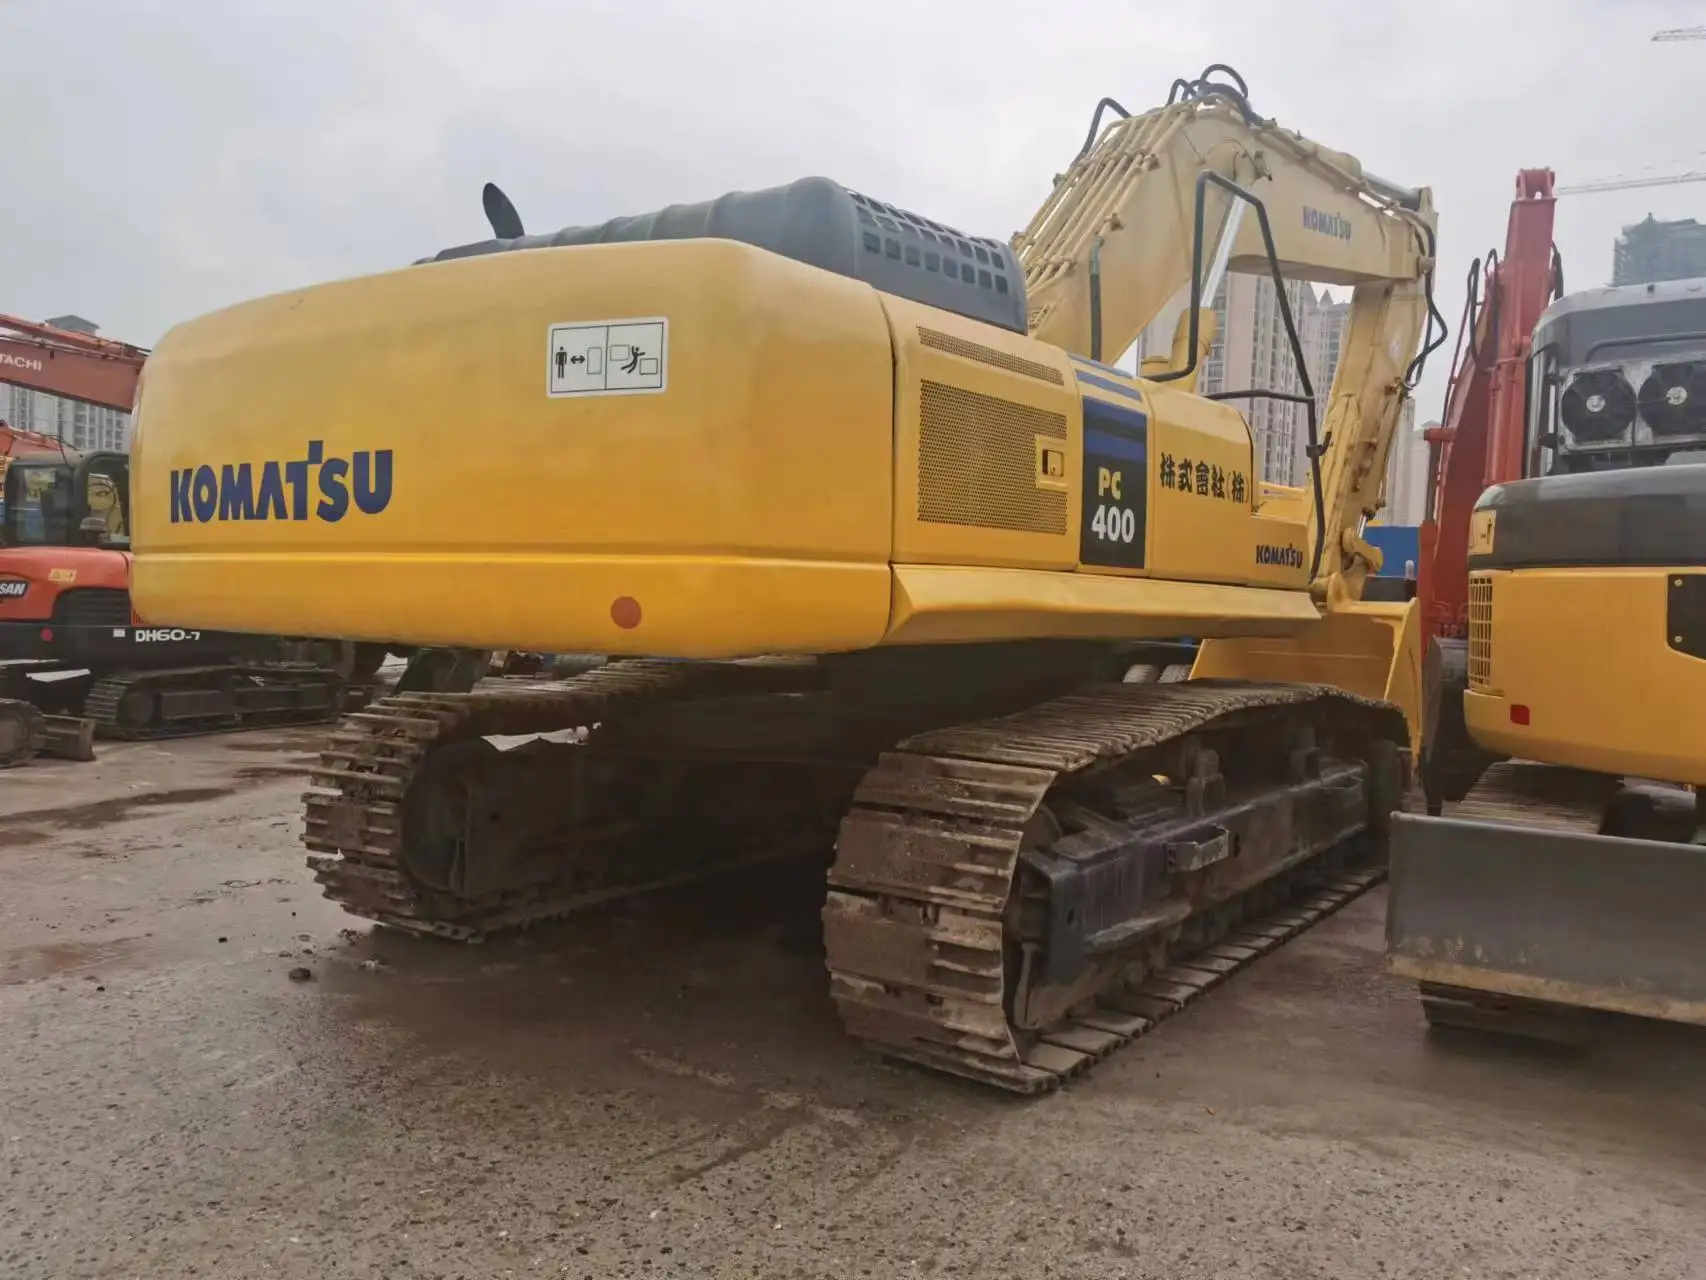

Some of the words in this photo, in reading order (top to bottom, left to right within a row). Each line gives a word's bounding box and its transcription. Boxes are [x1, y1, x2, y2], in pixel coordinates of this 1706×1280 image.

[1303, 205, 1351, 241] KOMATSU
[170, 440, 393, 523] KOMATSU
[1098, 466, 1121, 500] PC
[1092, 504, 1135, 543] 400
[1256, 543, 1303, 569] KOMATSU
[135, 629, 200, 642] DH60-7
